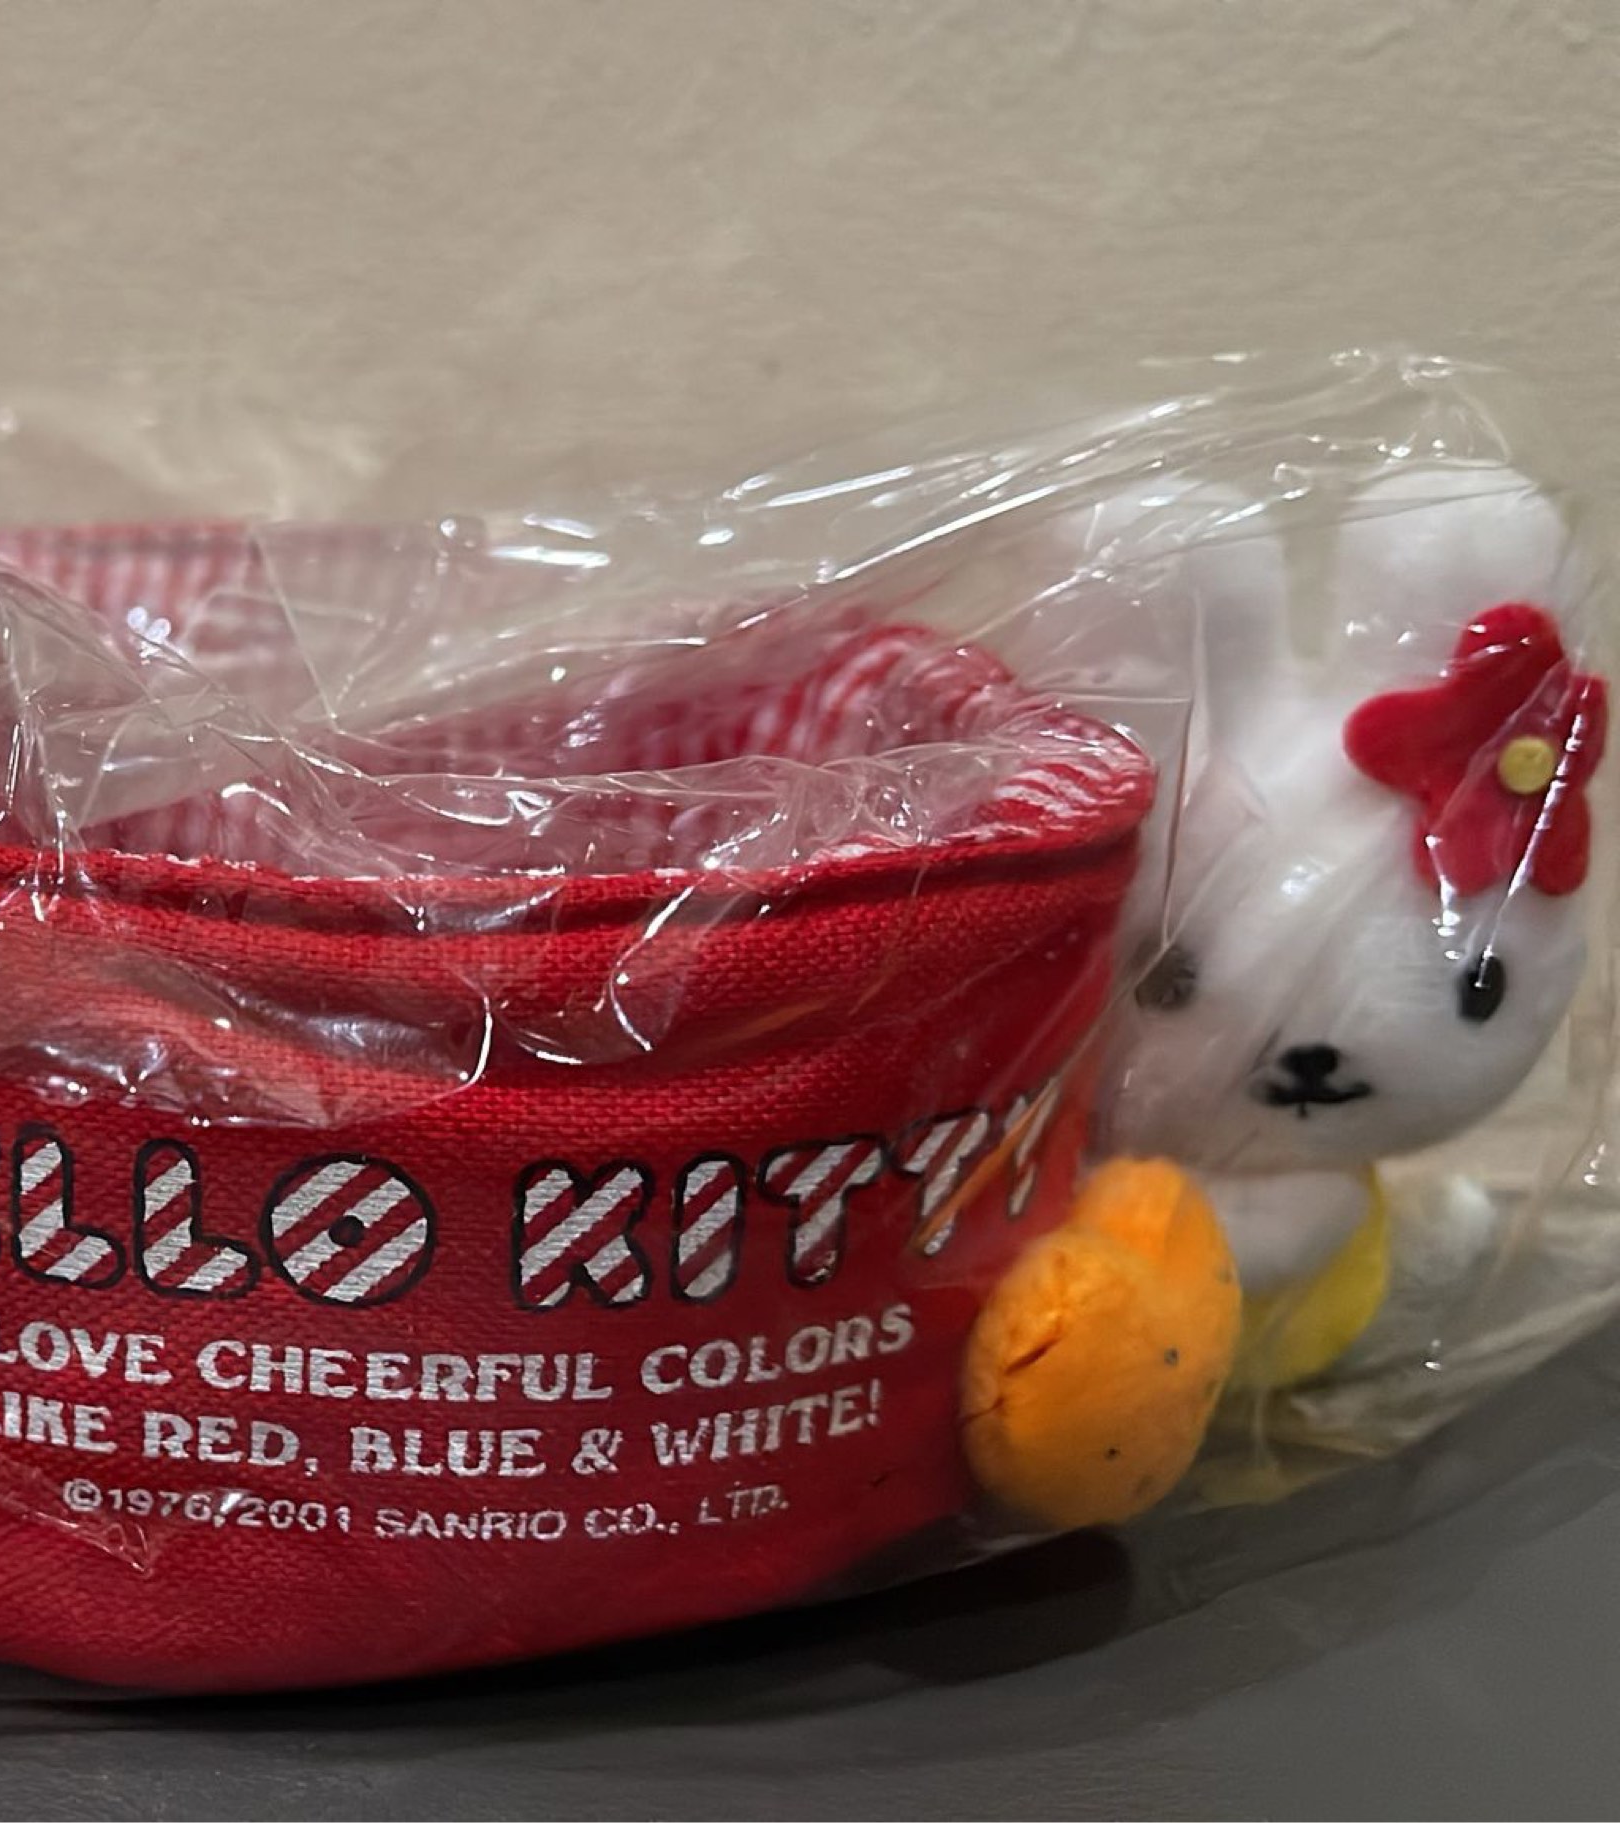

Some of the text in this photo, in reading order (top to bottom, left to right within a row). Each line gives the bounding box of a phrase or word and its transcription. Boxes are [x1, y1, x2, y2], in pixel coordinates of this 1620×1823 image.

[196, 1340, 615, 1401] CHEERFUL
[639, 1304, 917, 1395] COLORS
[142, 1411, 319, 1476] RED,
[350, 1427, 547, 1477] BLUE
[571, 1428, 623, 1475] &
[650, 1378, 881, 1467] WHITE!
[374, 1507, 568, 1541] SANRIO
[584, 1503, 681, 1541] CO.,
[698, 1482, 790, 1526] LTD.
